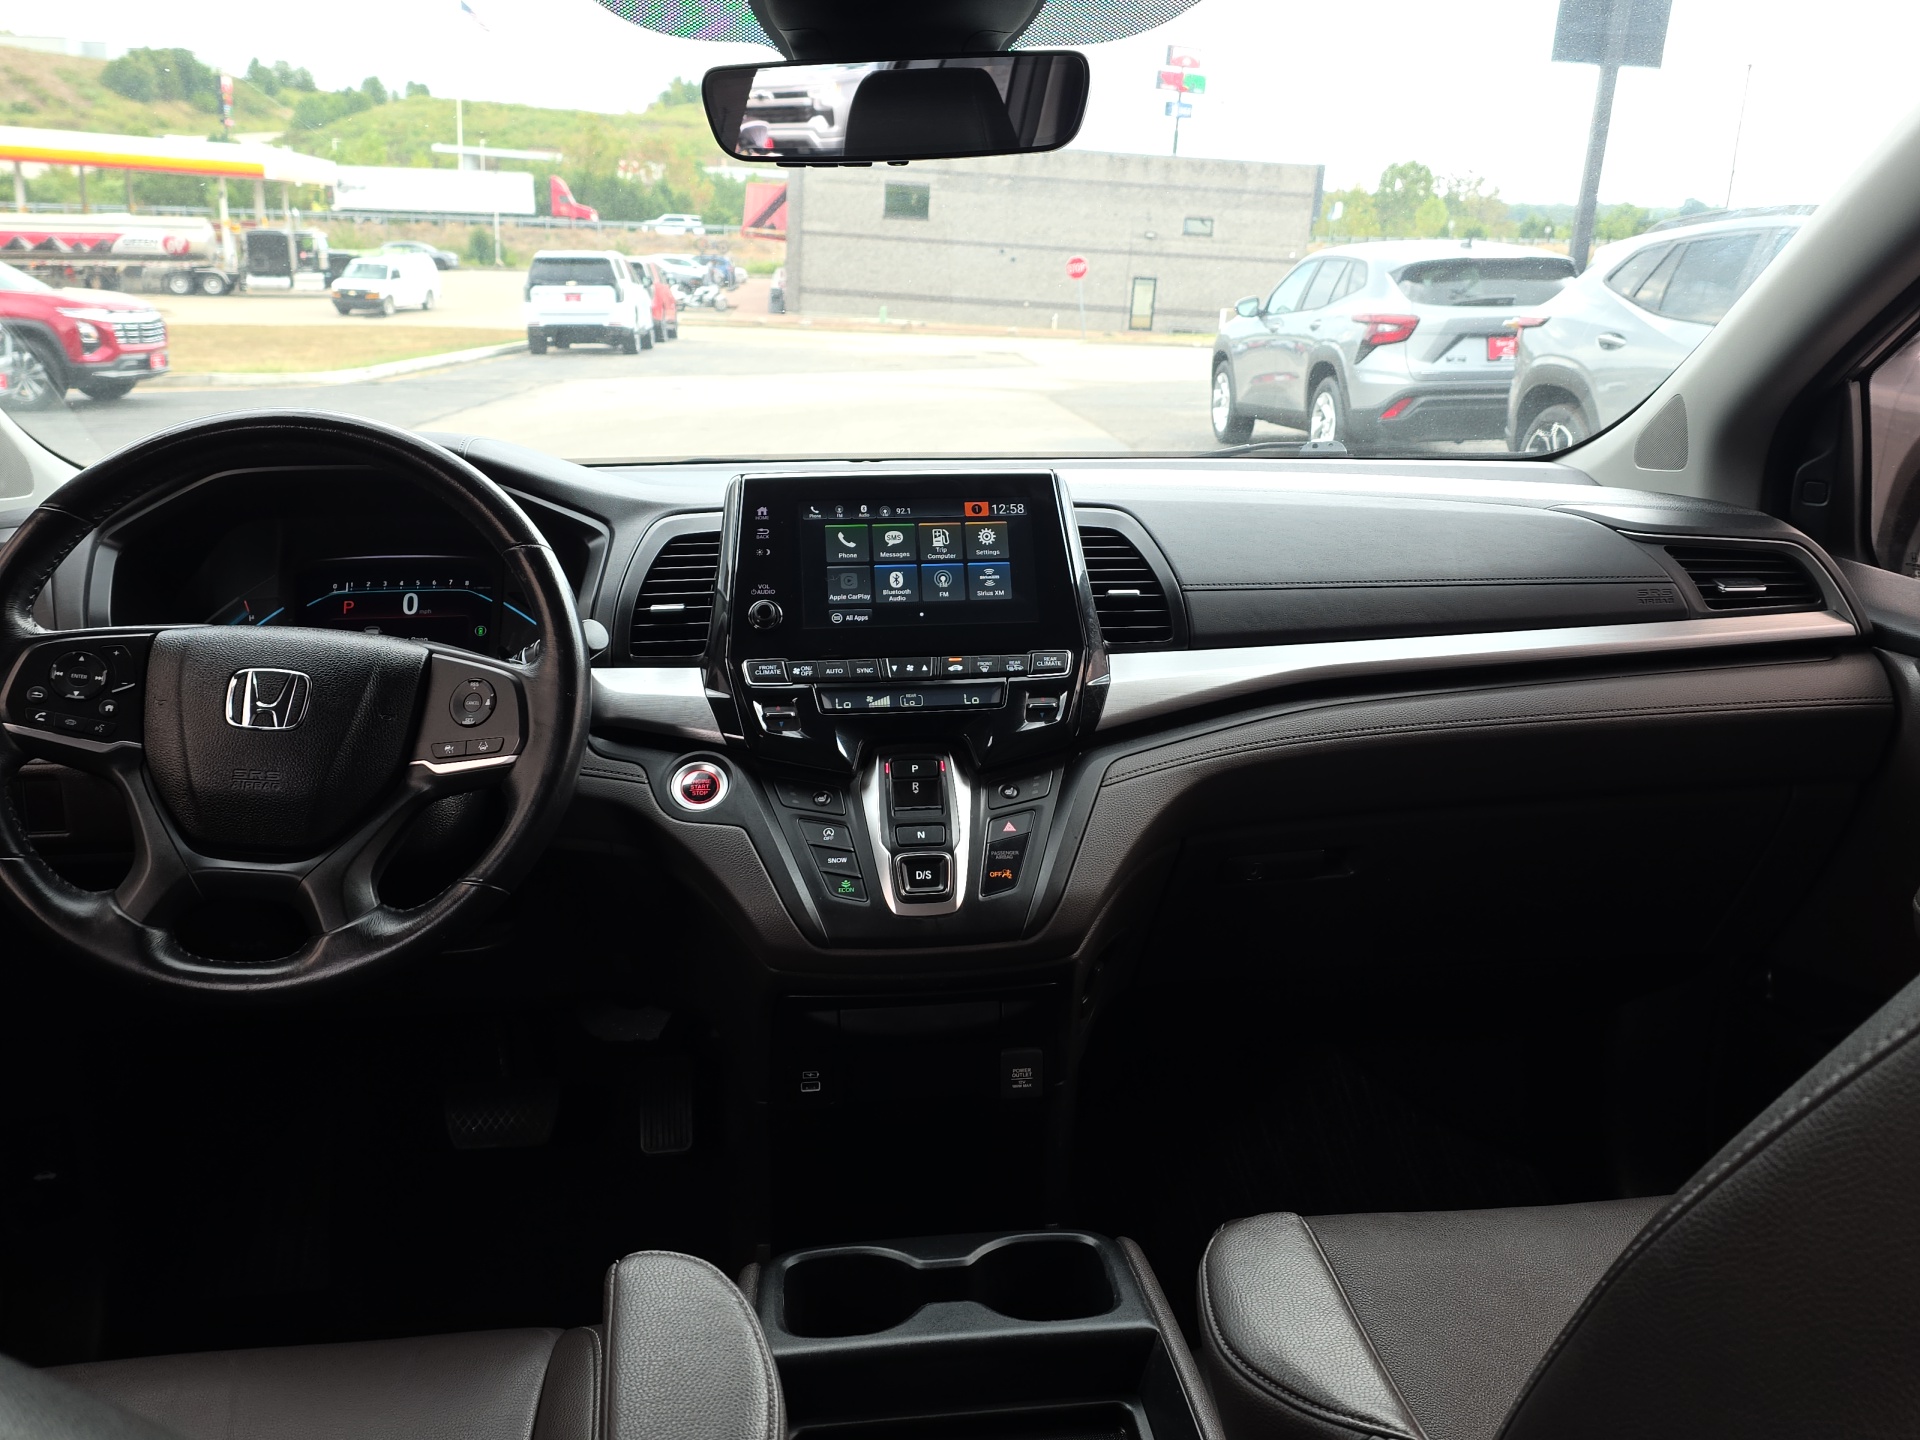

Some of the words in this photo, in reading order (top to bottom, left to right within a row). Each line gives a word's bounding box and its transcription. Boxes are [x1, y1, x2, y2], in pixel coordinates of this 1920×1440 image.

[991, 504, 1025, 514] 12:58
[1637, 588, 1673, 598] SRS
[343, 600, 354, 614] P
[402, 593, 418, 615] 0
[836, 698, 852, 709] Lo
[904, 698, 916, 706] Lo
[964, 694, 980, 705] Lo
[232, 769, 280, 780] SRS
[912, 782, 919, 790] R
[916, 871, 932, 880] D/S
